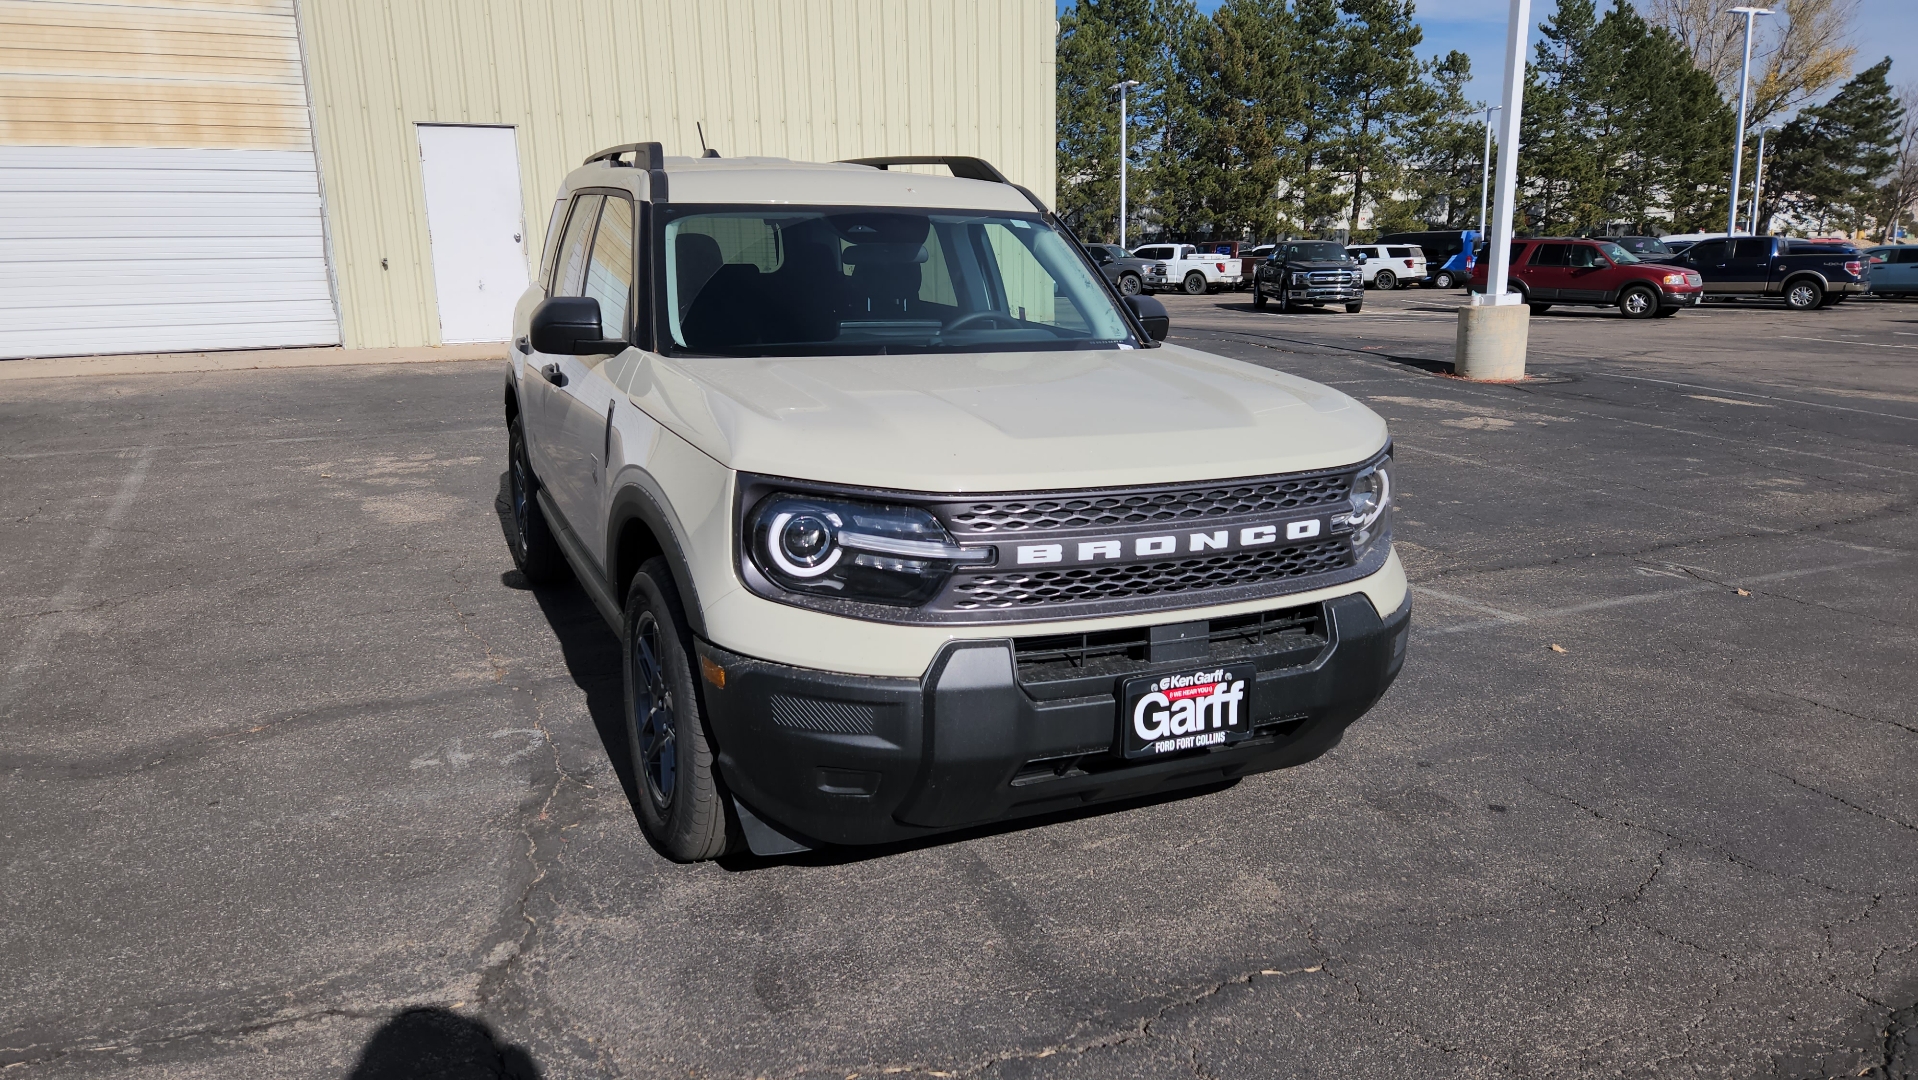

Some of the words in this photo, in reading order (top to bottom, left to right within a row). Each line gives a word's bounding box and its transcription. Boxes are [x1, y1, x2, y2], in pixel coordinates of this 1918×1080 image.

[1017, 519, 1320, 564] BRONCO
[1171, 674, 1193, 689] Ken
[1194, 669, 1224, 685] Garff
[1183, 688, 1198, 696] HEAR
[1197, 686, 1209, 694] YOU
[1134, 680, 1245, 741] Garff
[1155, 740, 1175, 754] FORD
[1176, 736, 1195, 750] FORT
[1195, 731, 1226, 747] COLLINS
